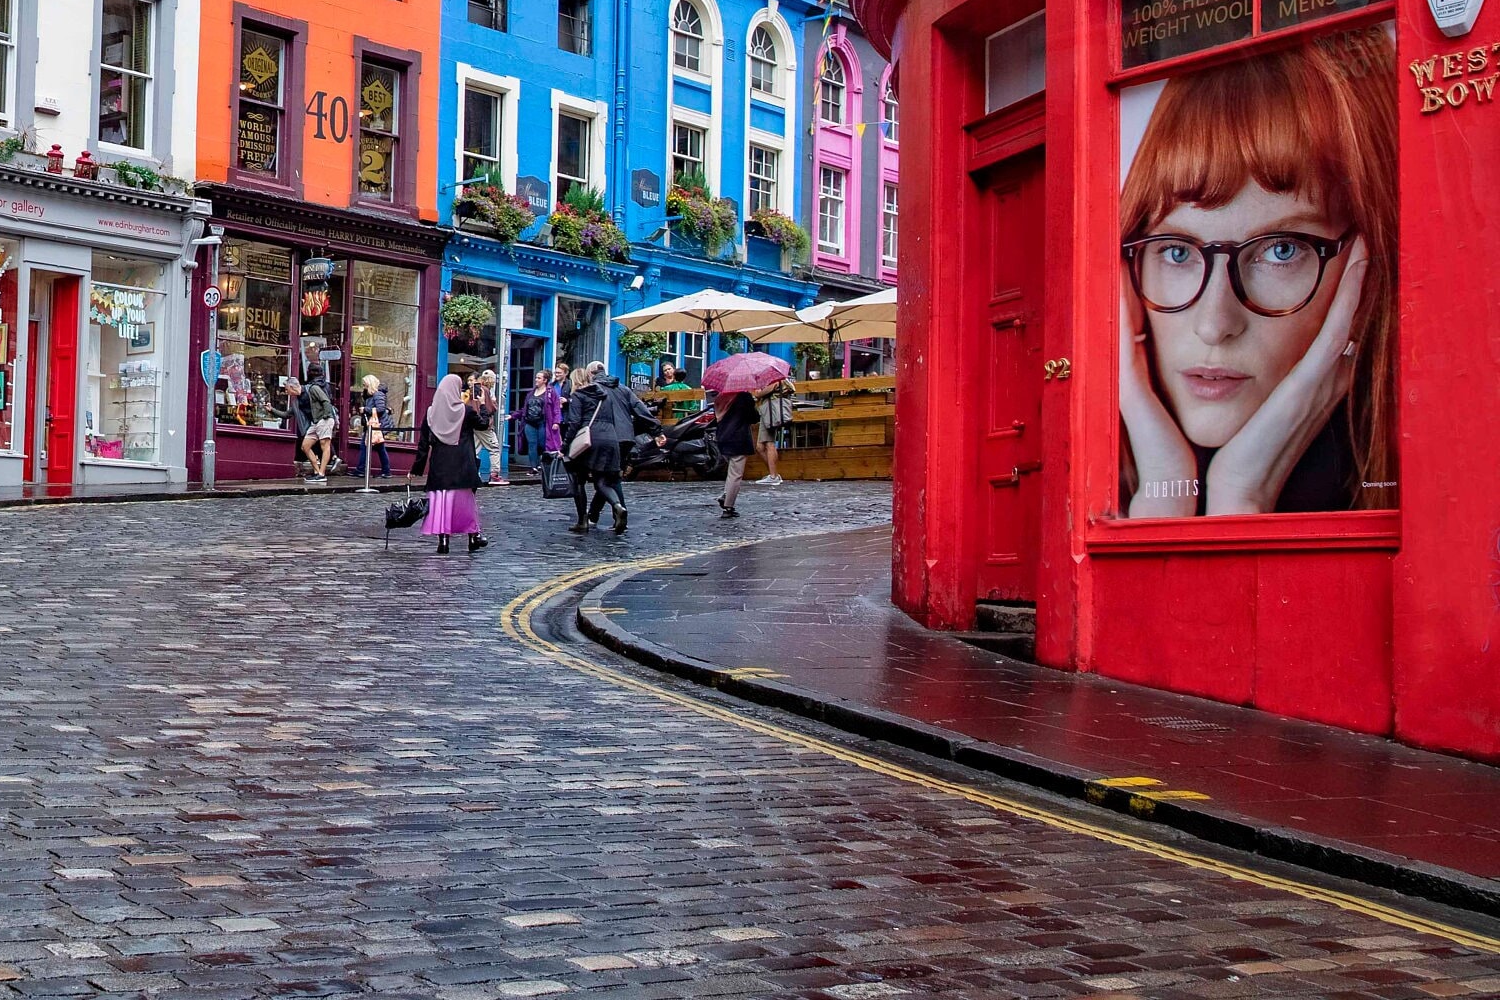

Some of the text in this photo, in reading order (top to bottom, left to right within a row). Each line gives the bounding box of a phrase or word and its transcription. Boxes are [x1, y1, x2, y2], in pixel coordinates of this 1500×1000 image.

[1122, 14, 1192, 49] WEIGHT
[368, 88, 387, 105] BEST
[1420, 72, 1500, 113] BOW
[239, 119, 272, 134] WORLD
[306, 91, 349, 144] 40
[237, 139, 276, 153] DMISSION
[361, 150, 385, 185] 2
[528, 195, 548, 209] BLEUE
[642, 190, 660, 202] BLEUE
[11, 199, 45, 218] gallery
[98, 218, 171, 237] www.edinburghart.com
[226, 209, 254, 224] Retailer
[254, 215, 264, 225] of
[264, 216, 298, 233] Officially
[298, 222, 326, 238] Licensed
[328, 227, 357, 243] HARRY
[356, 234, 387, 250] POTTER
[113, 289, 146, 309] COLOUR
[126, 307, 147, 326] YOUR
[118, 323, 140, 341] LIFE!
[1043, 357, 1071, 381] 92
[1145, 478, 1200, 499] CUBITTS
[1361, 481, 1383, 490] Coming
